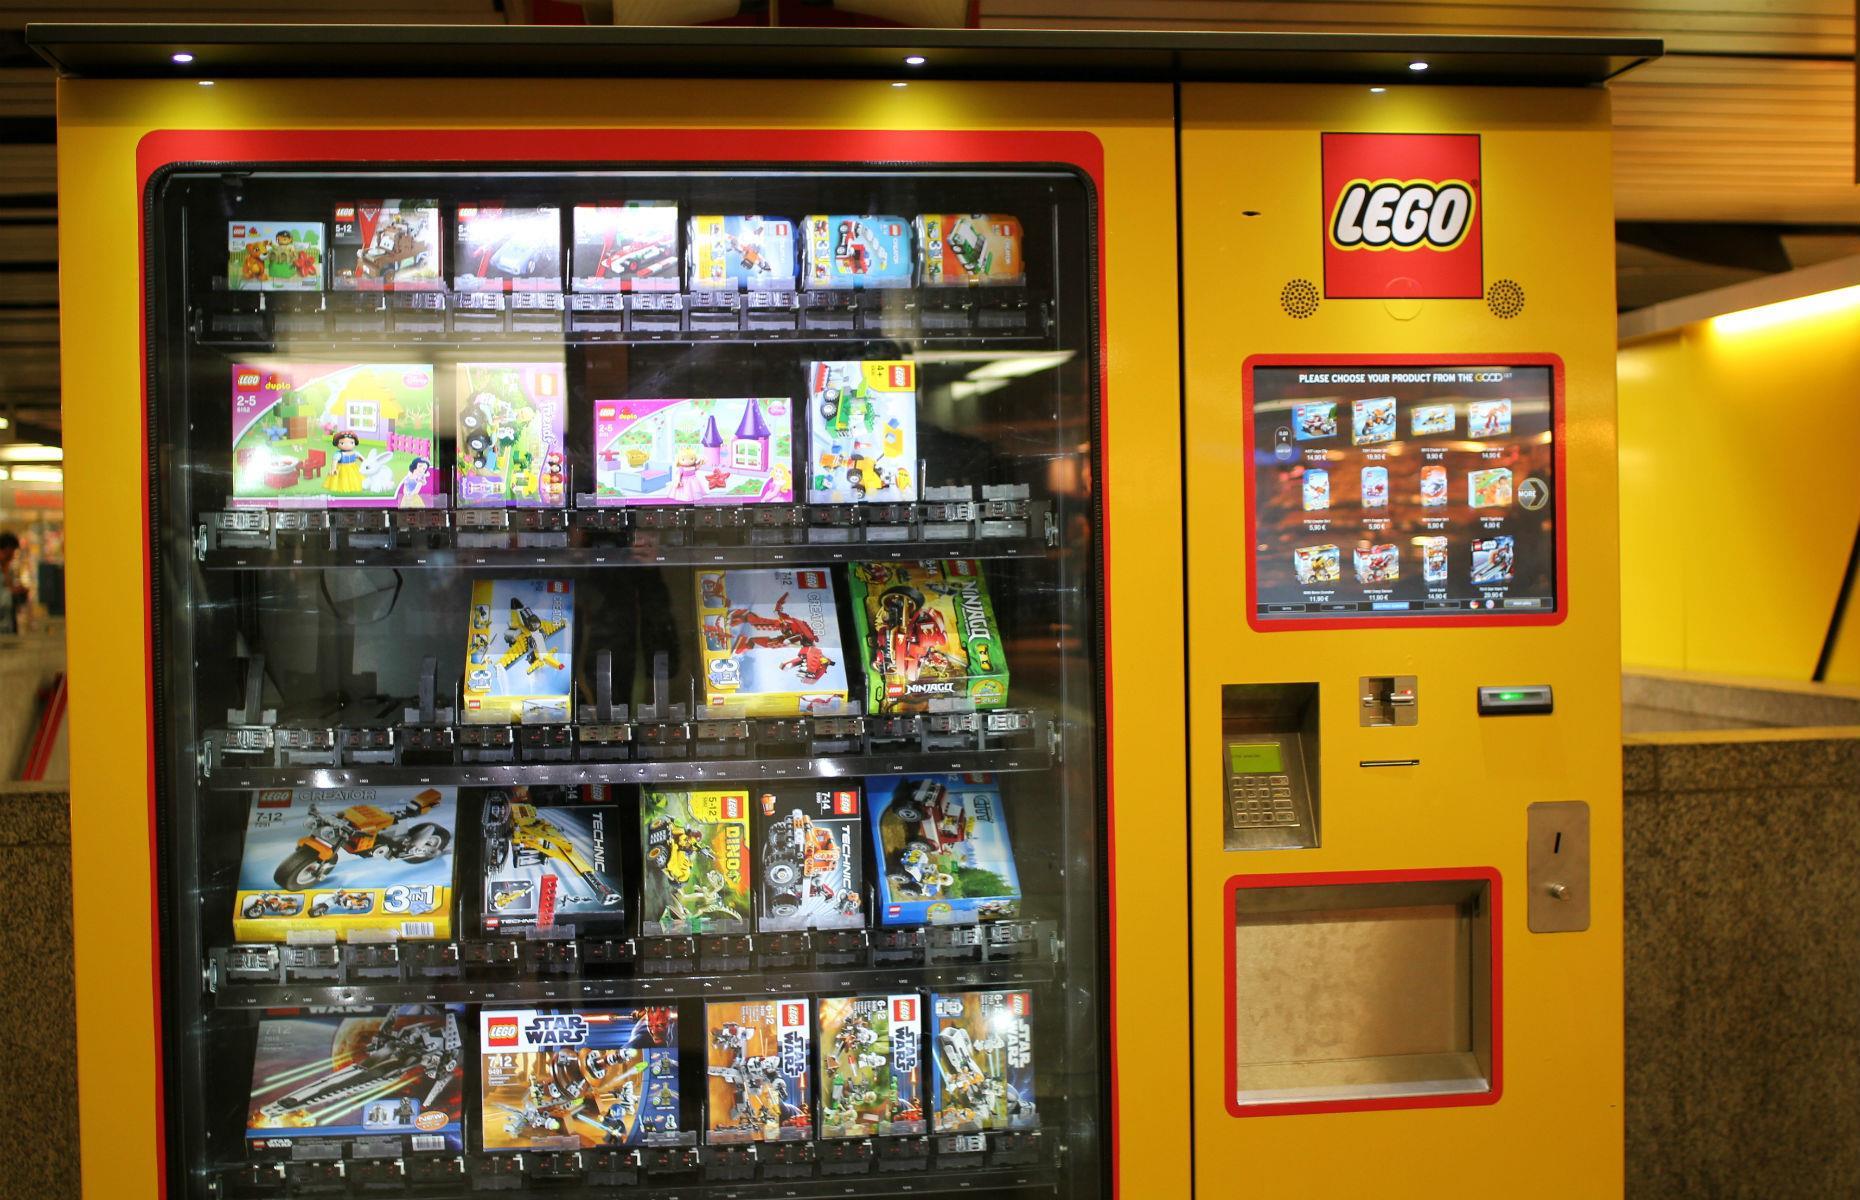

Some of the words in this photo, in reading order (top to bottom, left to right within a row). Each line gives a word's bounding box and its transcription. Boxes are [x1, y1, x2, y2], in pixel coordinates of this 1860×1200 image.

[336, 208, 354, 216] LEGO
[1331, 181, 1473, 249] LEGO
[336, 225, 352, 233] 5-12
[238, 375, 260, 386] LEGO
[894, 366, 906, 387] LEGO
[1299, 373, 1330, 383] PLEASE
[1332, 373, 1366, 383] CHOOSE
[1368, 373, 1390, 383] YOUR
[1392, 373, 1432, 382] PRODUCT
[1433, 373, 1456, 382] FROM
[1457, 373, 1474, 382] THE
[265, 382, 291, 391] duplo
[237, 396, 256, 406] 2-5
[599, 408, 616, 417] LEGO
[619, 412, 638, 420] duplo
[599, 424, 613, 432] 2-5
[958, 561, 969, 576] LEGO
[554, 582, 564, 592] LEGO
[806, 572, 818, 589] LEGO
[552, 596, 564, 627] CREATOR
[808, 592, 826, 639] CREATOR
[962, 580, 991, 642] NINJAGO
[710, 659, 740, 673] 3
[905, 682, 956, 696] NINJAGO
[262, 791, 290, 800] LEGO
[298, 790, 376, 800] CREATOR
[822, 792, 831, 810] 7-14
[840, 792, 851, 814] LEGO
[708, 796, 717, 816] 5-12
[726, 798, 738, 818] LEGO
[256, 812, 282, 822] 7-12
[591, 812, 606, 873] TECHNIC
[842, 824, 852, 890] TECHNIC
[384, 884, 410, 912] 3
[410, 893, 423, 902] IN
[424, 884, 434, 904] 1
[766, 1005, 774, 1024] 6-12
[788, 1005, 799, 1024] LEGO
[878, 1000, 886, 1020] 6-12
[900, 1001, 910, 1019] LEGO
[265, 1026, 292, 1034] 7-12
[525, 1016, 587, 1030] STAR
[488, 1026, 518, 1039] LEGO
[525, 1030, 588, 1044] WARS
[896, 1026, 906, 1070] WARS
[904, 1026, 915, 1071] STAR
[1019, 1018, 1030, 1068] STAR
[784, 1032, 794, 1076] WARS
[794, 1031, 804, 1076] STAR
